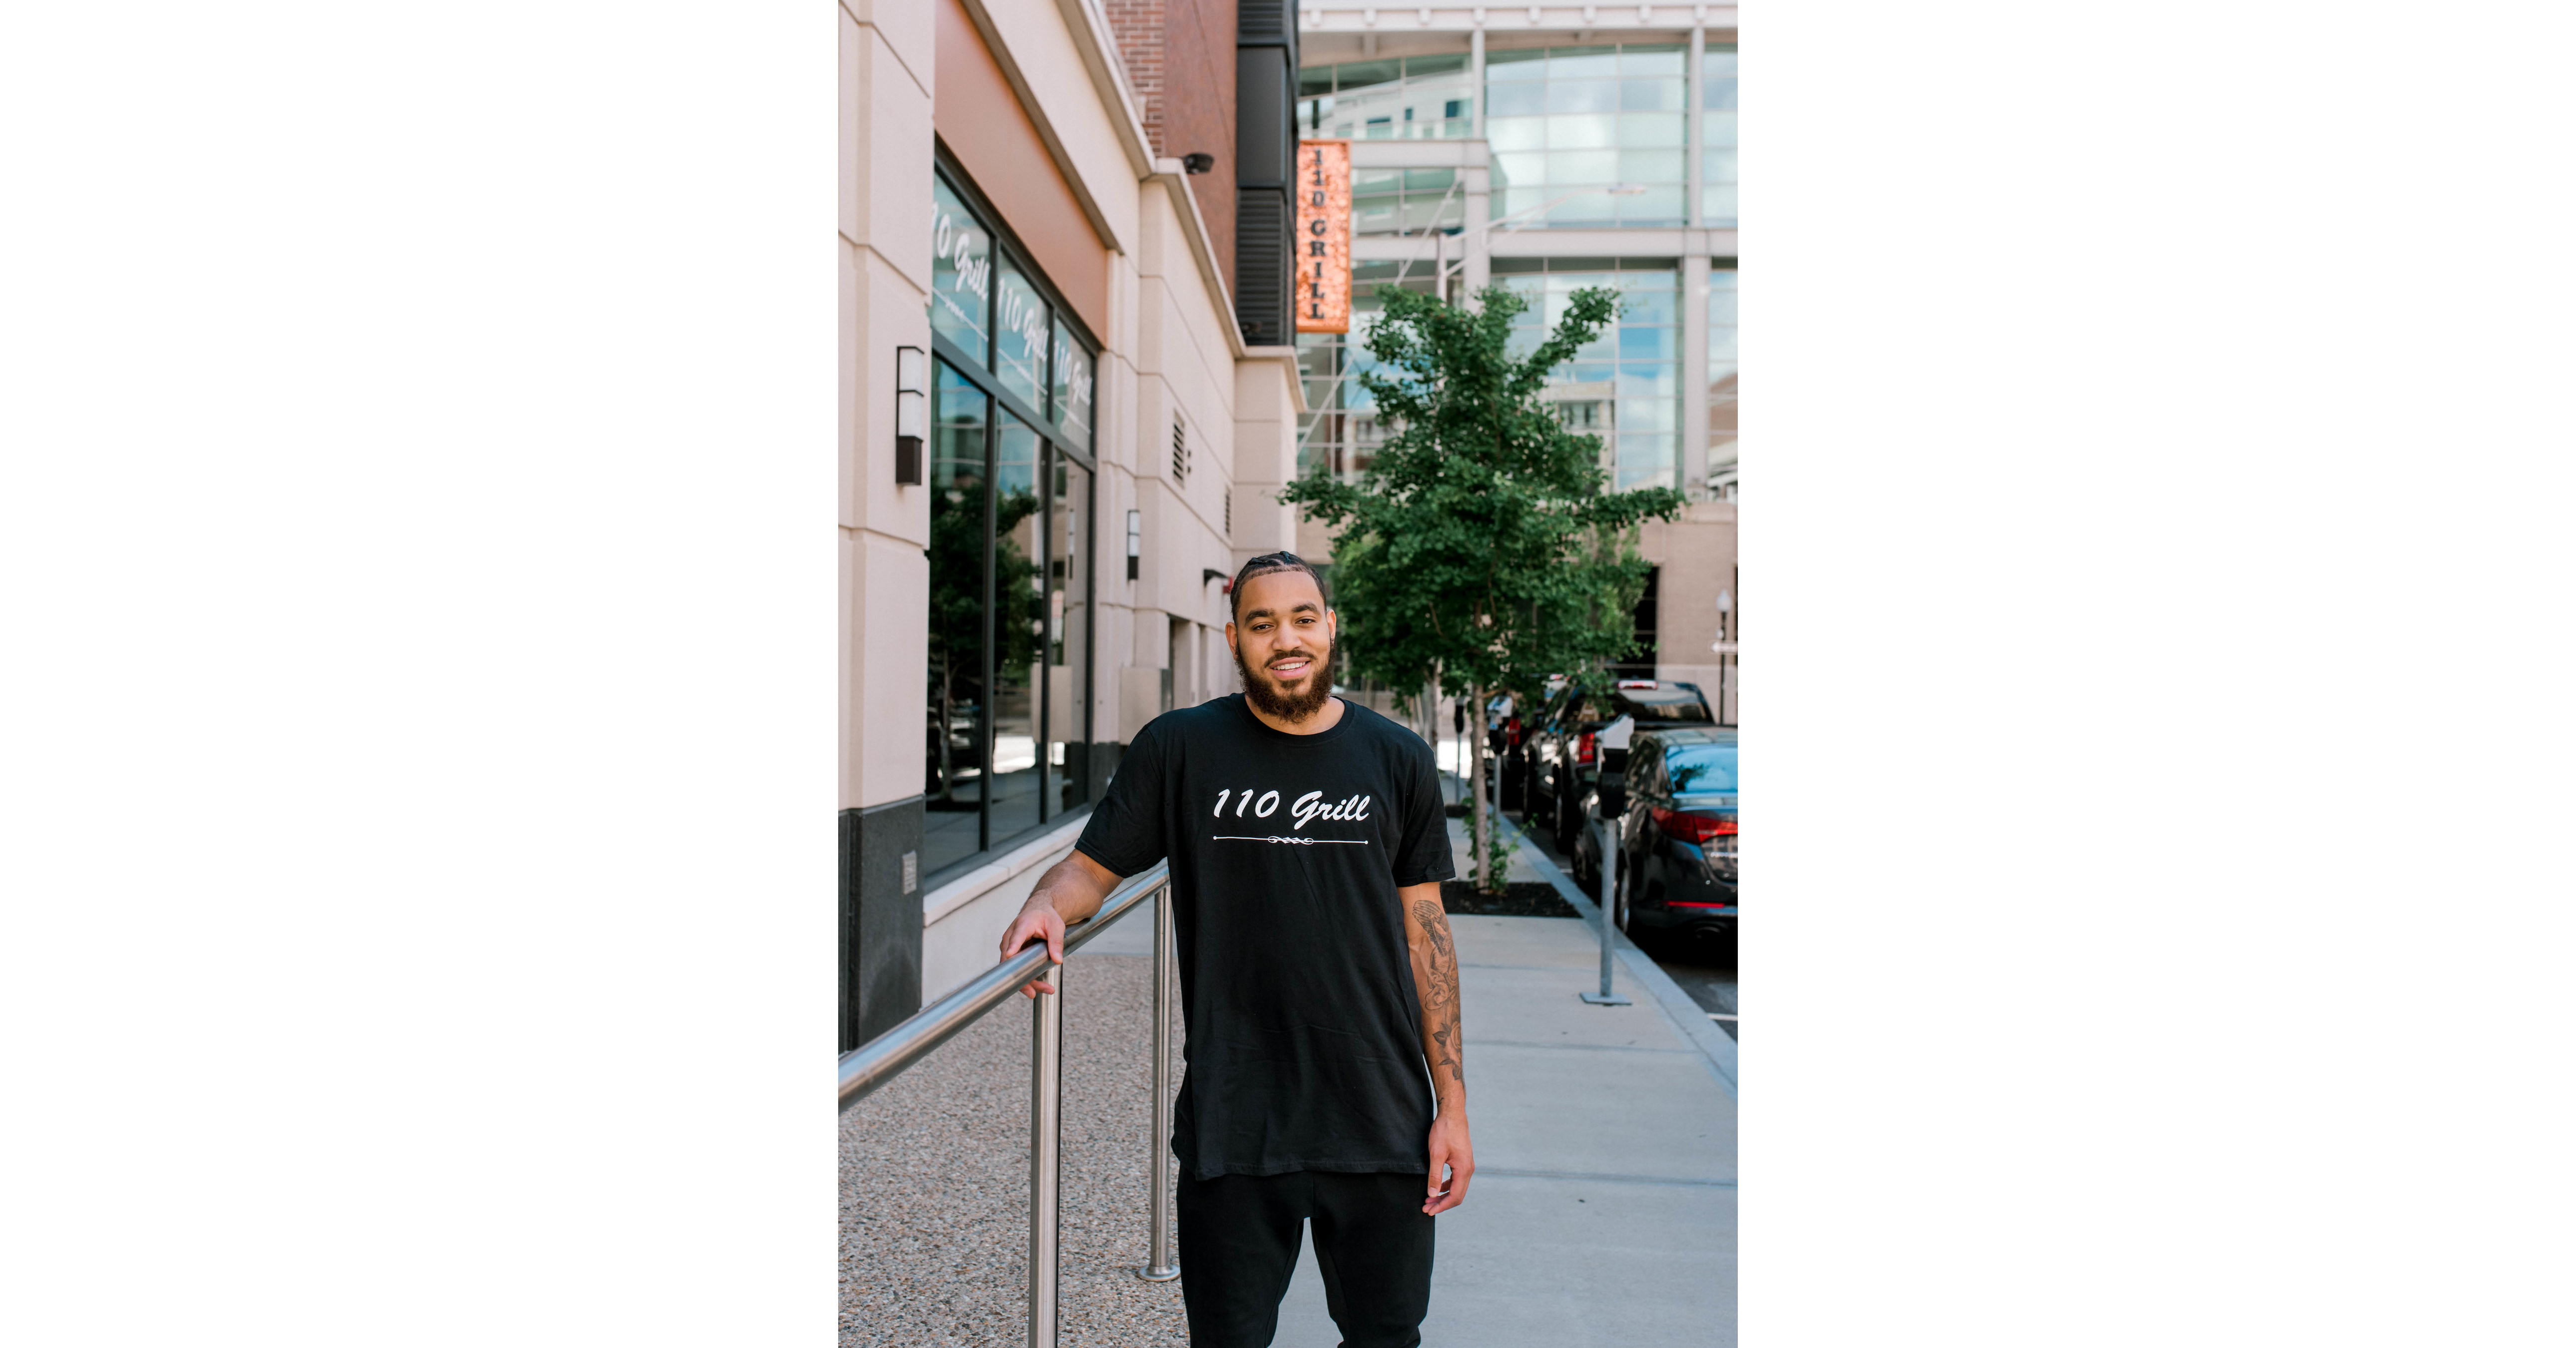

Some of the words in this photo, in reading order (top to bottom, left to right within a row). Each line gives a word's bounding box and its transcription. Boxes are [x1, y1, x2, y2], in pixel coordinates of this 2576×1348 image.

[1312, 148, 1325, 207] 110
[955, 233, 991, 301] Grill
[1310, 220, 1327, 320] GRILL
[997, 278, 1022, 333] 110
[1023, 308, 1048, 362] Grill
[1213, 789, 1280, 818] 110
[1291, 790, 1371, 830] Grill
